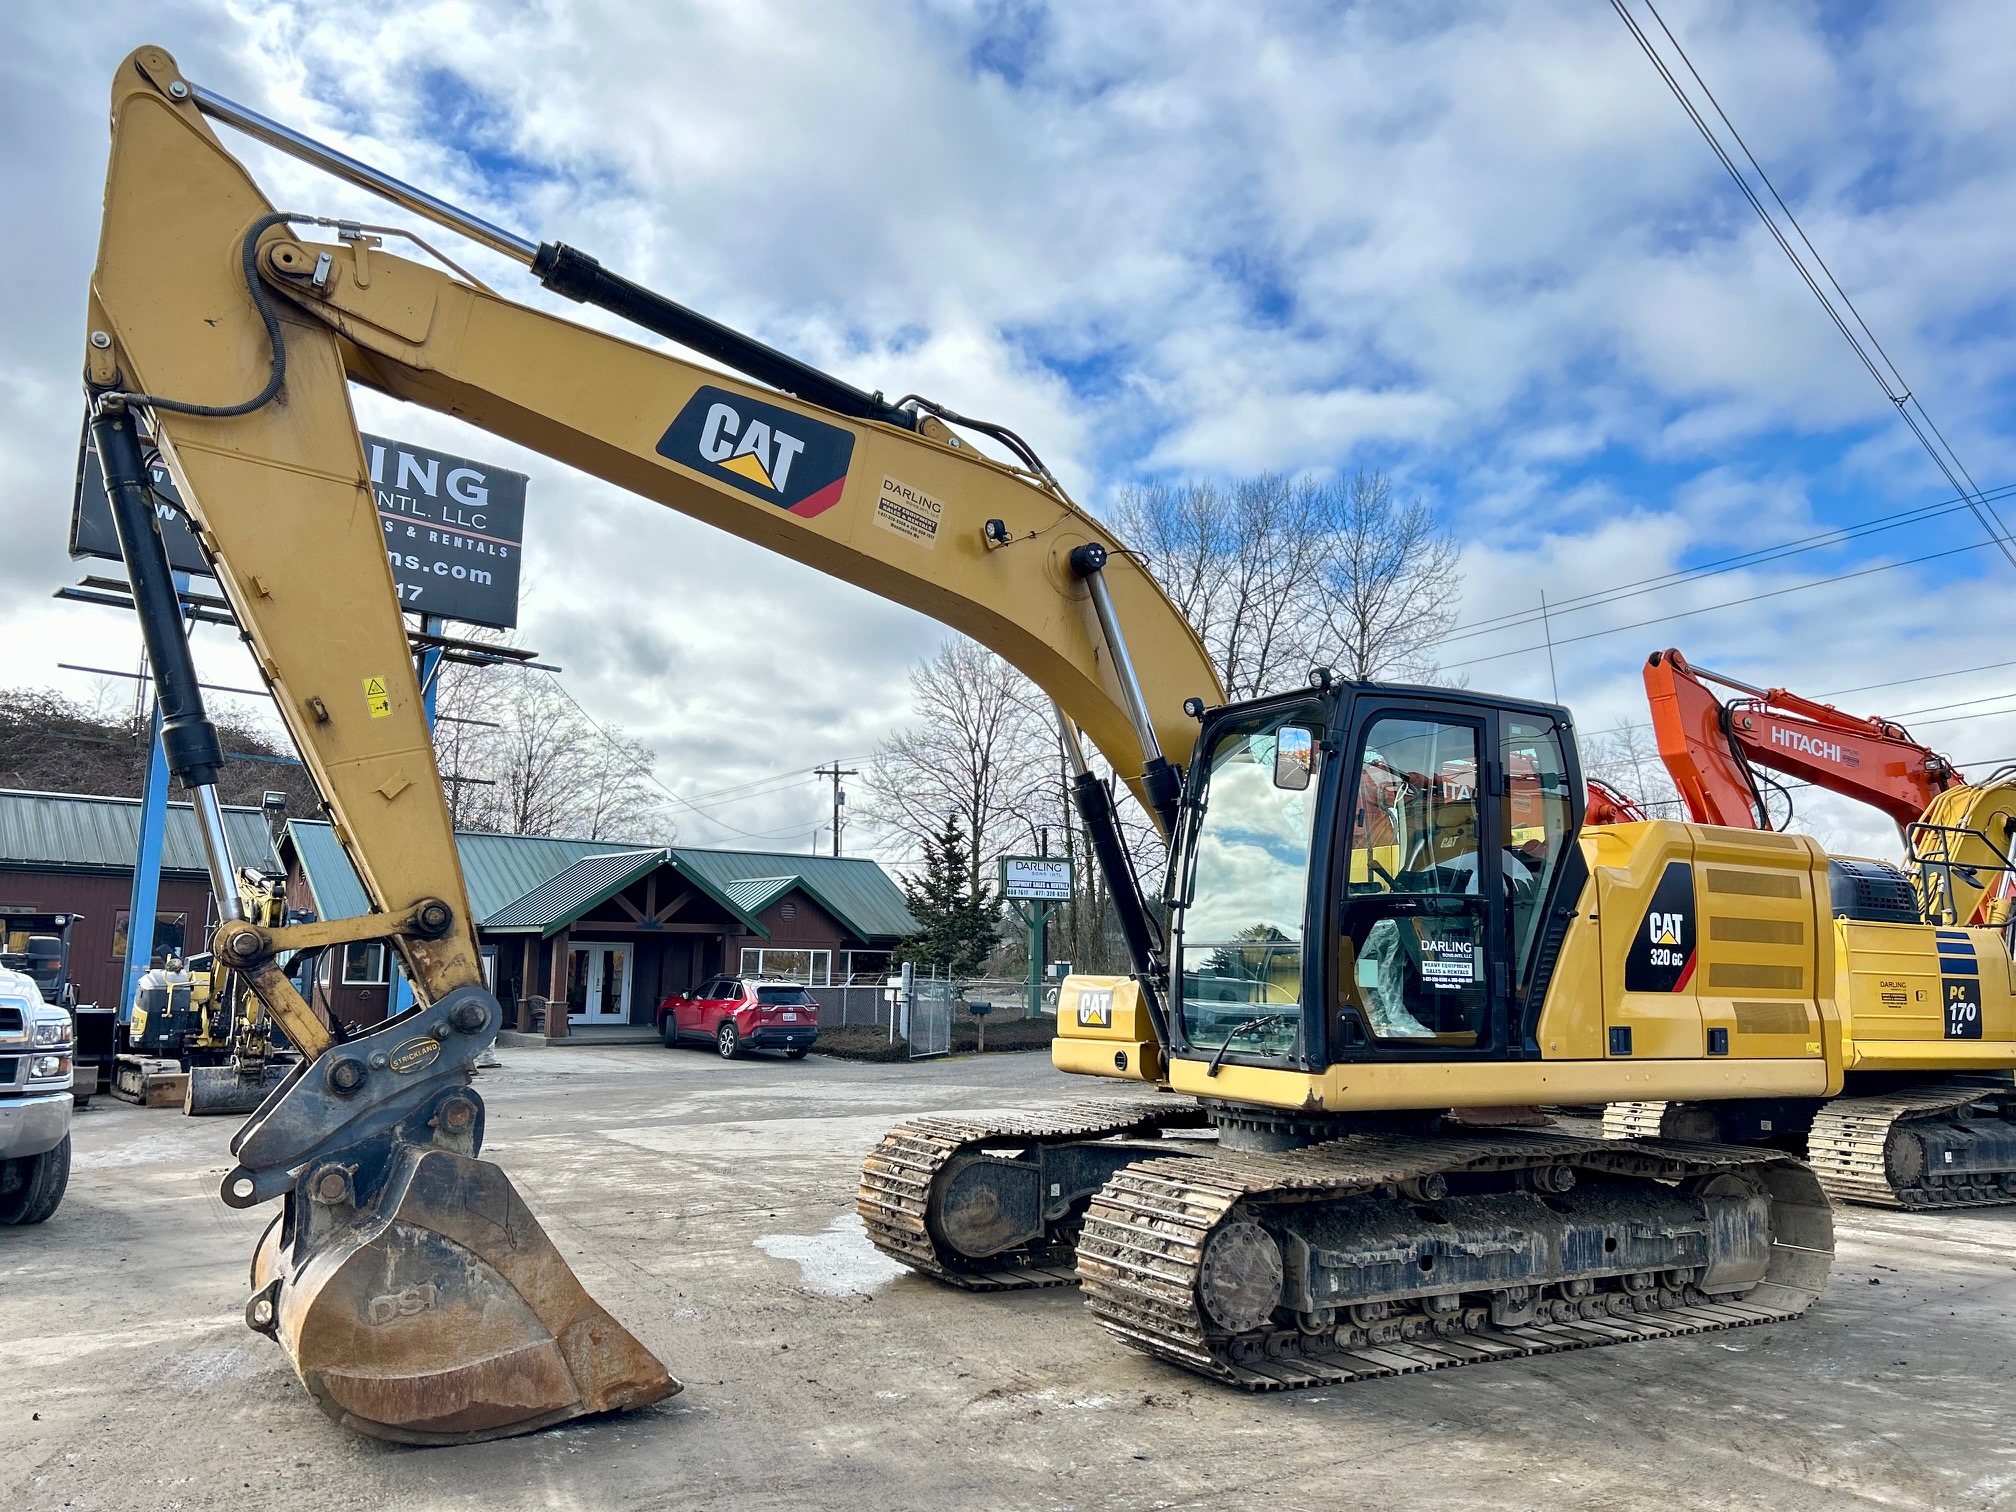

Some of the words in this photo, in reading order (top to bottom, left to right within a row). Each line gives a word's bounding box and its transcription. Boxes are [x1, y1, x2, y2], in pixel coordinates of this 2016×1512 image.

[699, 402, 805, 494] CAT
[373, 489, 431, 518] NTL.
[442, 506, 487, 529] LLC
[883, 479, 941, 513] DARLING
[881, 499, 902, 512] HEAVY
[901, 507, 936, 527] EQUIPMENT
[882, 505, 902, 517] SALES
[906, 516, 933, 532] RENTALS
[406, 525, 417, 538] &
[429, 530, 508, 558] RENTALS
[1771, 725, 1841, 763] HITACHI
[1440, 836, 1459, 849] CAT
[1016, 861, 1062, 872] DARLING
[1649, 912, 1684, 945] CAT
[1421, 940, 1472, 953] DARLING
[1650, 949, 1670, 966] 320
[1671, 953, 1683, 966] GC
[1949, 985, 1966, 1000] PC
[1080, 993, 1110, 1025] CAT
[1949, 1002, 1977, 1022] 170
[1951, 1022, 1963, 1035] LC
[393, 1043, 438, 1067] STRICKLAND
